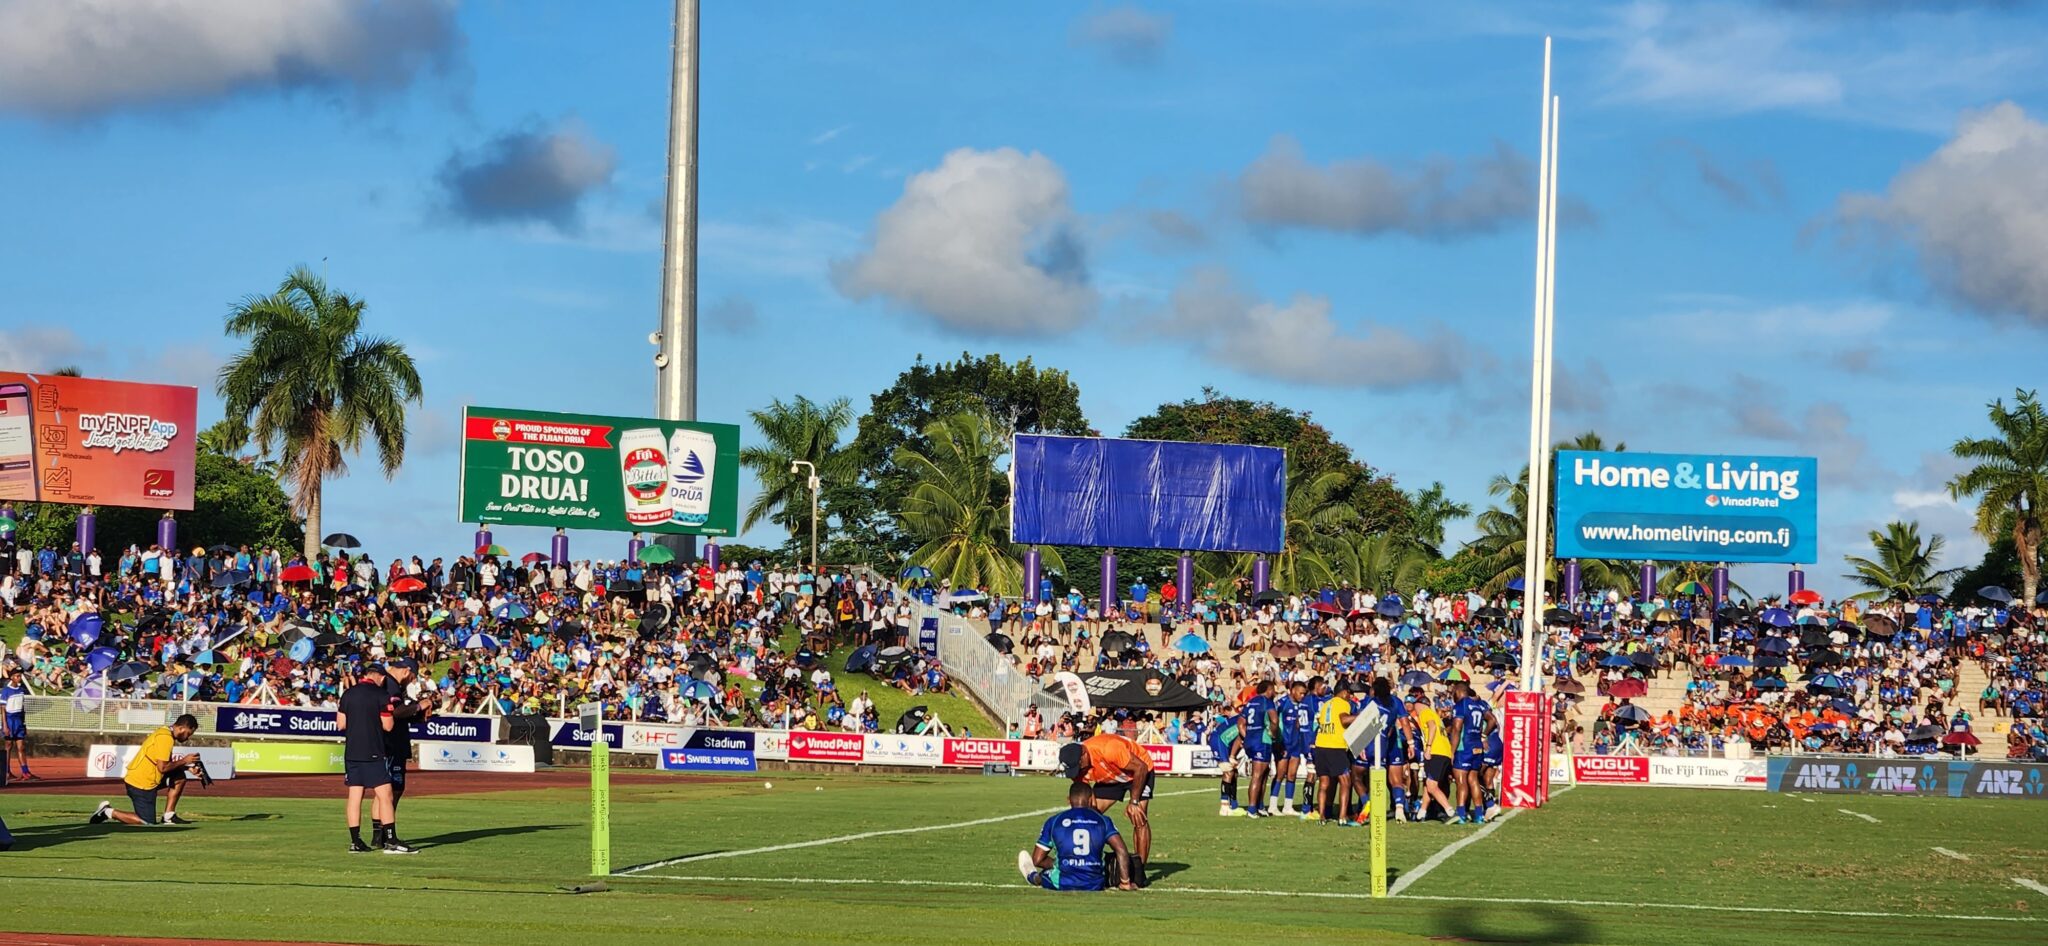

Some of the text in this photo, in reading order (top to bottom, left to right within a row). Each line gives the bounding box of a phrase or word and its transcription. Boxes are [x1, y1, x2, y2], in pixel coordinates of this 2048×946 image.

[79, 413, 176, 437] myFNPF App
[515, 423, 542, 432] PROUD
[543, 425, 579, 436] SPONSOR
[580, 428, 591, 436] OF
[522, 432, 586, 444] THE FIJIAN DRUA
[507, 446, 585, 474] TOSO
[1574, 458, 1800, 500] Home & Living
[149, 489, 173, 497] FNPF
[501, 473, 589, 502] DRUA!
[671, 487, 703, 501] DRUA
[1721, 496, 1779, 508] Vinod Patel
[1582, 524, 1790, 547] www.homeliving.com.fj
[249, 713, 282, 727] HFC
[1248, 708, 1256, 725] 2
[1471, 710, 1482, 727] 17
[427, 722, 477, 737] Stadium
[1511, 716, 1524, 749] Patel
[646, 731, 678, 744] HFC
[704, 736, 746, 749] Stadium
[807, 737, 862, 750] Vinod Patel
[952, 741, 1012, 755] MOGUL
[97, 755, 115, 770] MG
[686, 754, 749, 765] SWIRE SHIPPING
[1577, 758, 1640, 770] MOGUL
[1510, 749, 1522, 787] Vinod
[1653, 764, 1729, 777] The Fiji Times
[1794, 764, 1840, 789] ANZ
[1871, 766, 1917, 791] ANZ
[1976, 769, 2023, 794] ANZ
[1073, 829, 1090, 855] 9
